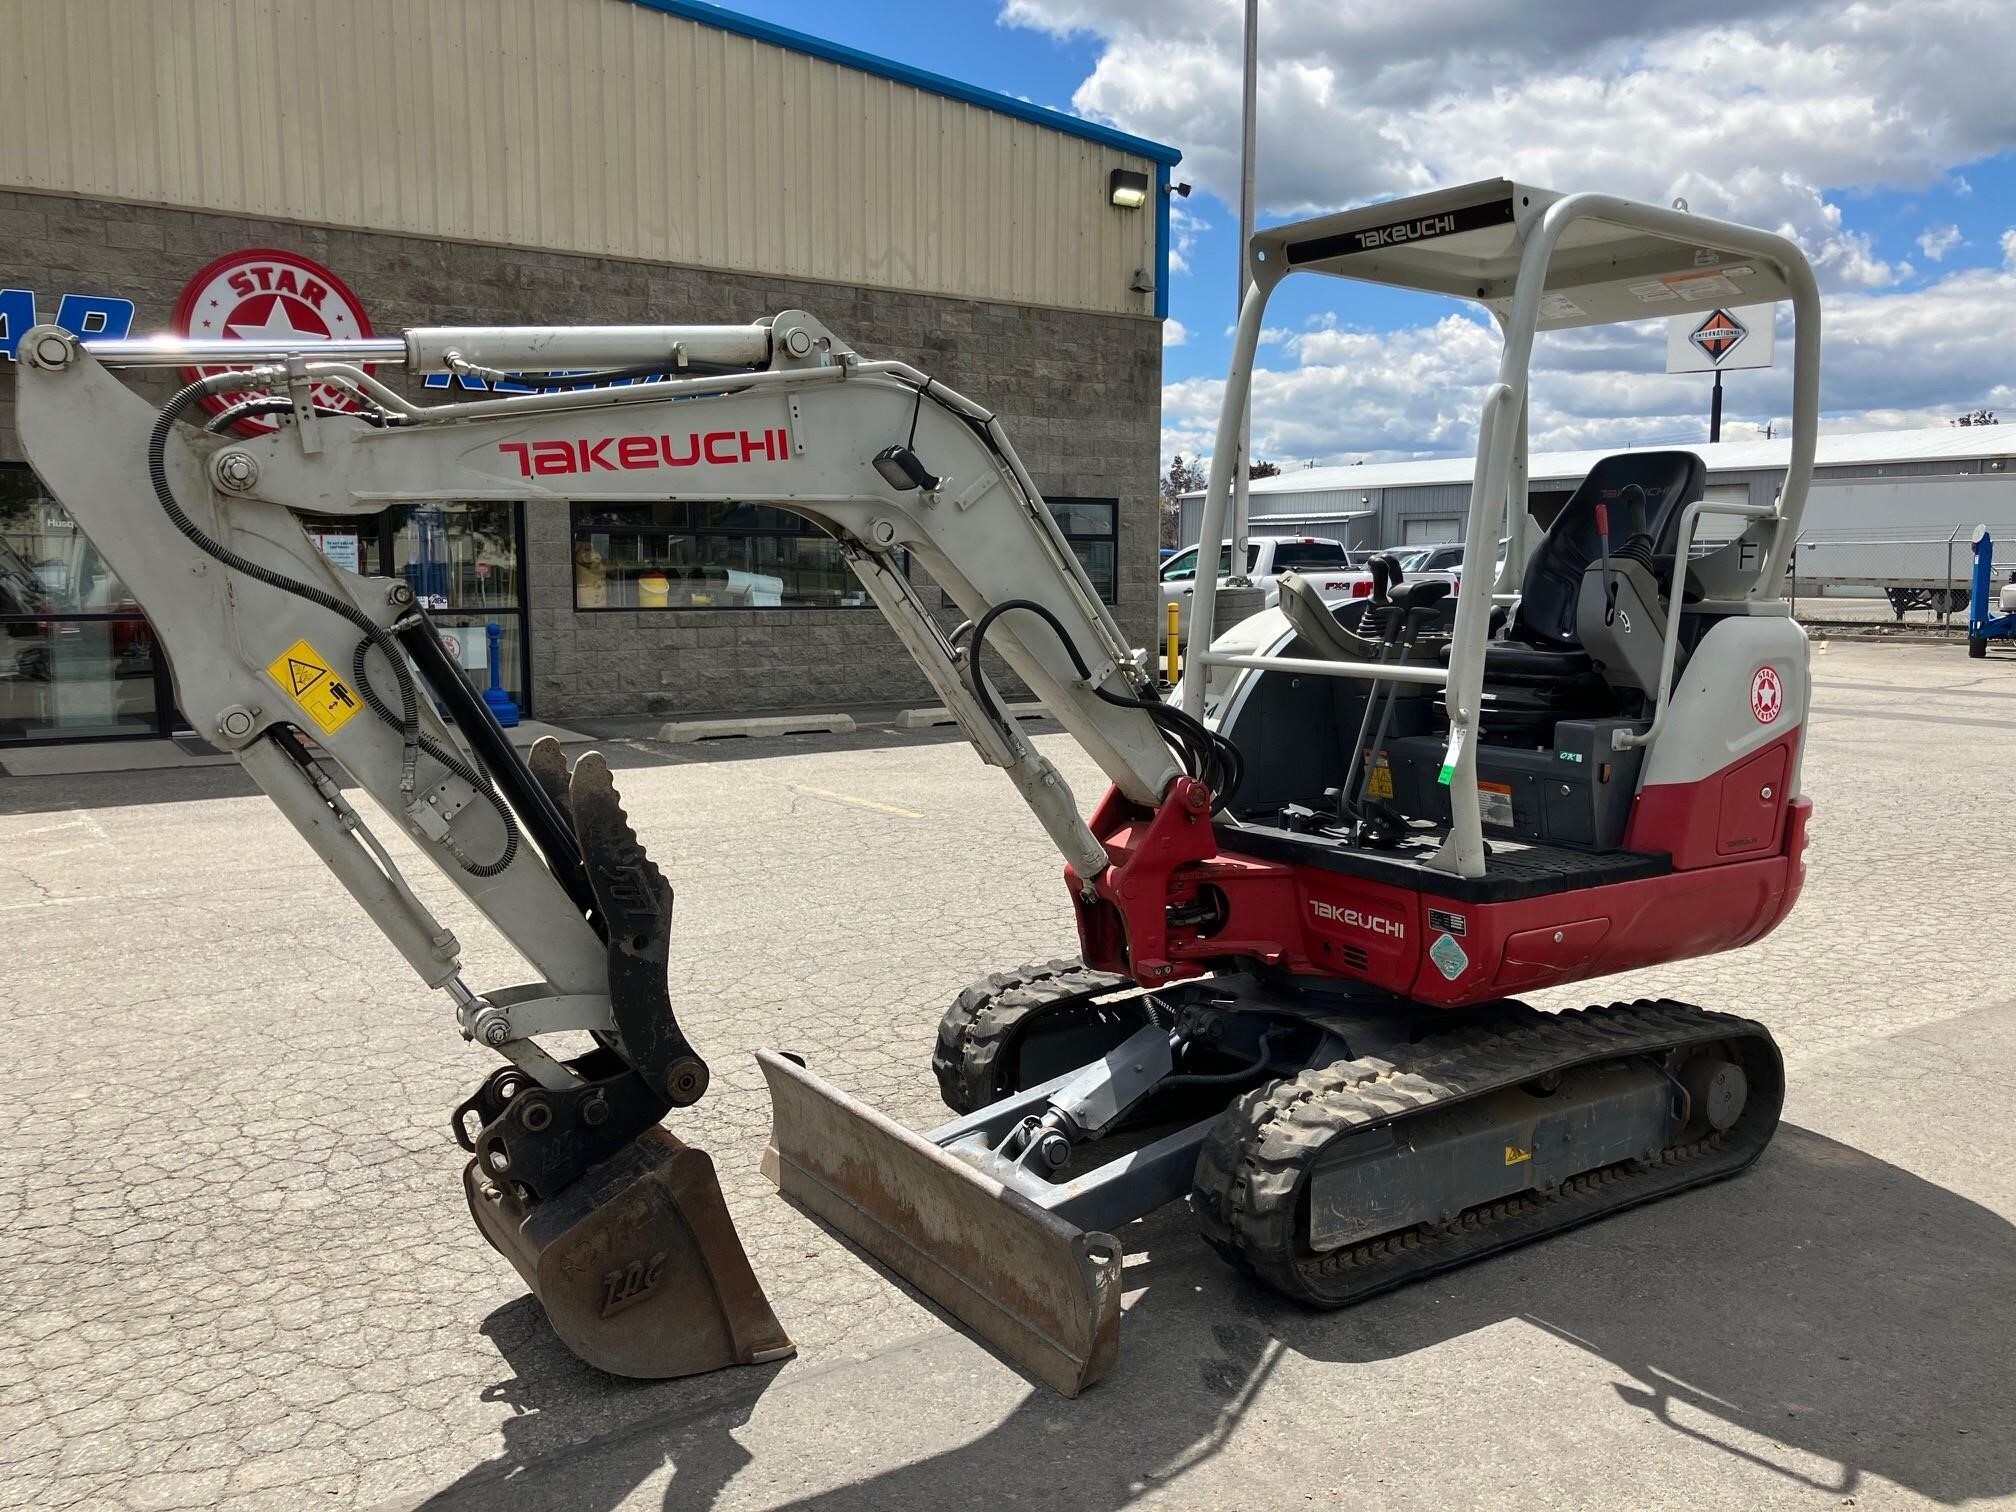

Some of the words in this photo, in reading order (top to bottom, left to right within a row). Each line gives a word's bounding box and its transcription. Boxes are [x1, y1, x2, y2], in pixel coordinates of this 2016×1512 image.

[1355, 215, 1455, 248] TAKEUCHI
[227, 267, 328, 311] STAR
[1696, 330, 1740, 338] INTERNATIONAL
[499, 428, 789, 477] TAKEUCHI
[1738, 543, 1758, 570] F
[1309, 899, 1405, 939] TAKEUCHI
